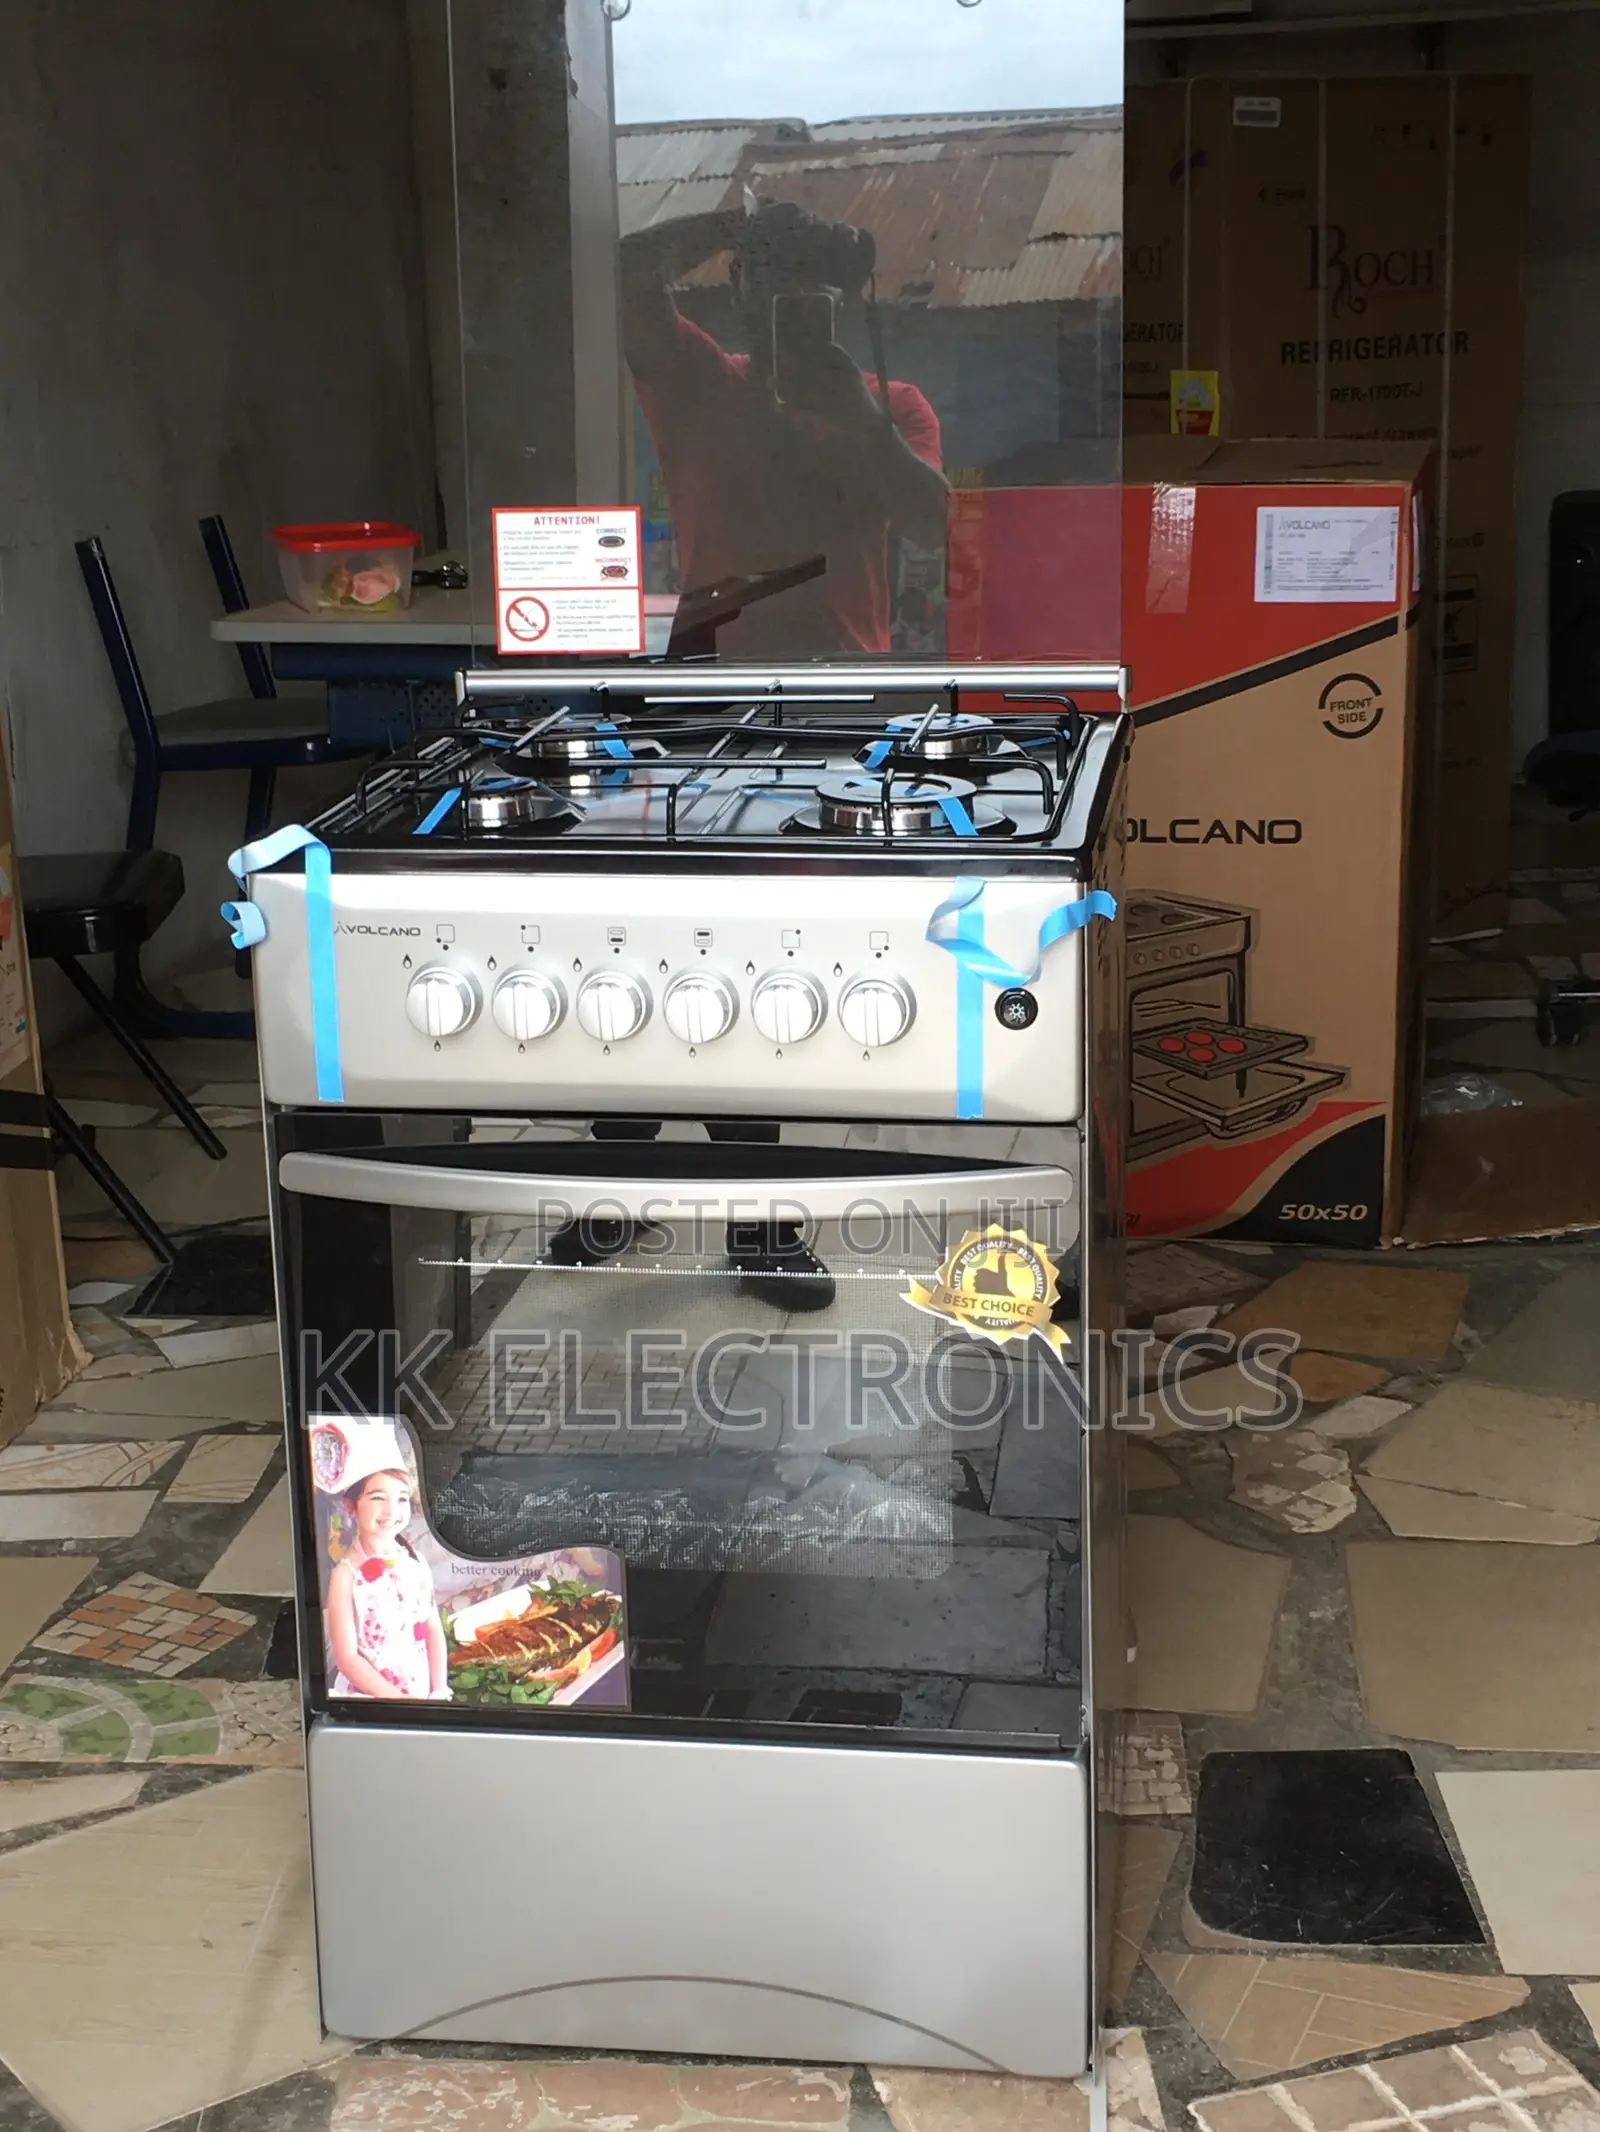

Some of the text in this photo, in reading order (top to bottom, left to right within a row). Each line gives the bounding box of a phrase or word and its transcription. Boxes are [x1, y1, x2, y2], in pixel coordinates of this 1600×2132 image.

[1124, 245, 1163, 277] OCH
[1303, 224, 1434, 320] ROCH
[533, 515, 600, 526] ATTENTION!
[1286, 520, 1330, 530] VOLCANO
[1330, 697, 1373, 713] FRONT
[1337, 711, 1367, 725] SIDE
[346, 923, 422, 937] VOLCANO
[1278, 1203, 1369, 1222] 50x50
[960, 1240, 1014, 1265] BEST QUALITY
[1017, 1247, 1044, 1299] BEST QUALITY
[943, 1292, 1036, 1318] BEST CHOICE
[451, 1563, 542, 1580] better cooking
